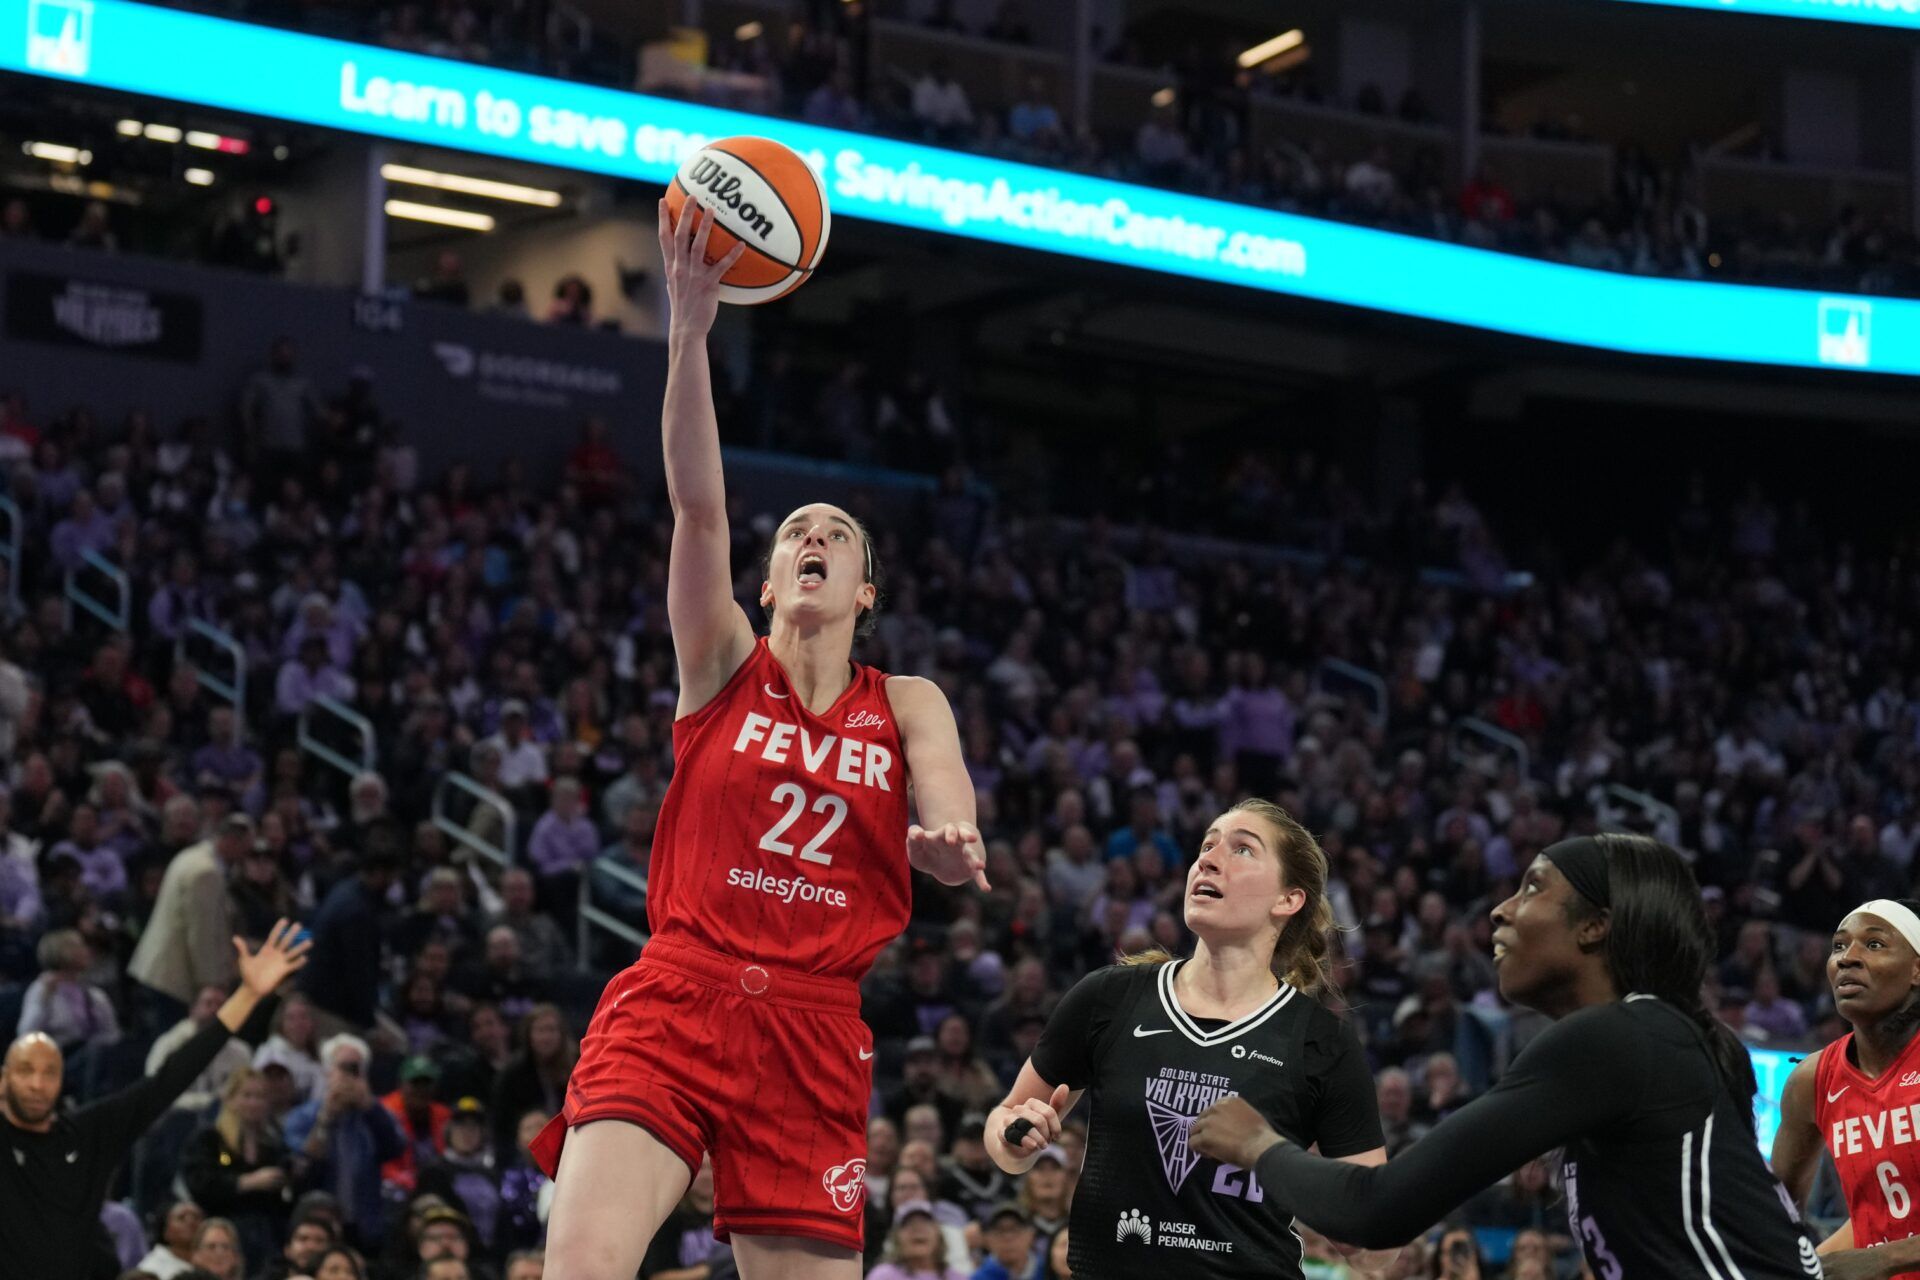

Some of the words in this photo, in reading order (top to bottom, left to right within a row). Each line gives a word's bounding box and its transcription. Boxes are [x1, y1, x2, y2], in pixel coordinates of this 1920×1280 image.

[339, 61, 468, 130] Learn
[474, 90, 522, 138] to
[528, 105, 628, 158] save
[834, 149, 1307, 277] SavingsActionCenter.com
[688, 155, 775, 241] Wilson
[844, 710, 886, 730] Lilly
[733, 711, 892, 792] FEVER
[758, 782, 848, 866] 22
[726, 867, 847, 908] salesforce
[1159, 1067, 1198, 1083] GOLDEN
[1199, 1073, 1231, 1088] STATE
[1247, 1050, 1284, 1067] freedom
[1145, 1077, 1240, 1115] VALKYRI
[1875, 1160, 1911, 1220] 6
[1158, 1235, 1233, 1253] PERMANENTE
[1159, 1221, 1196, 1235] KAISER
